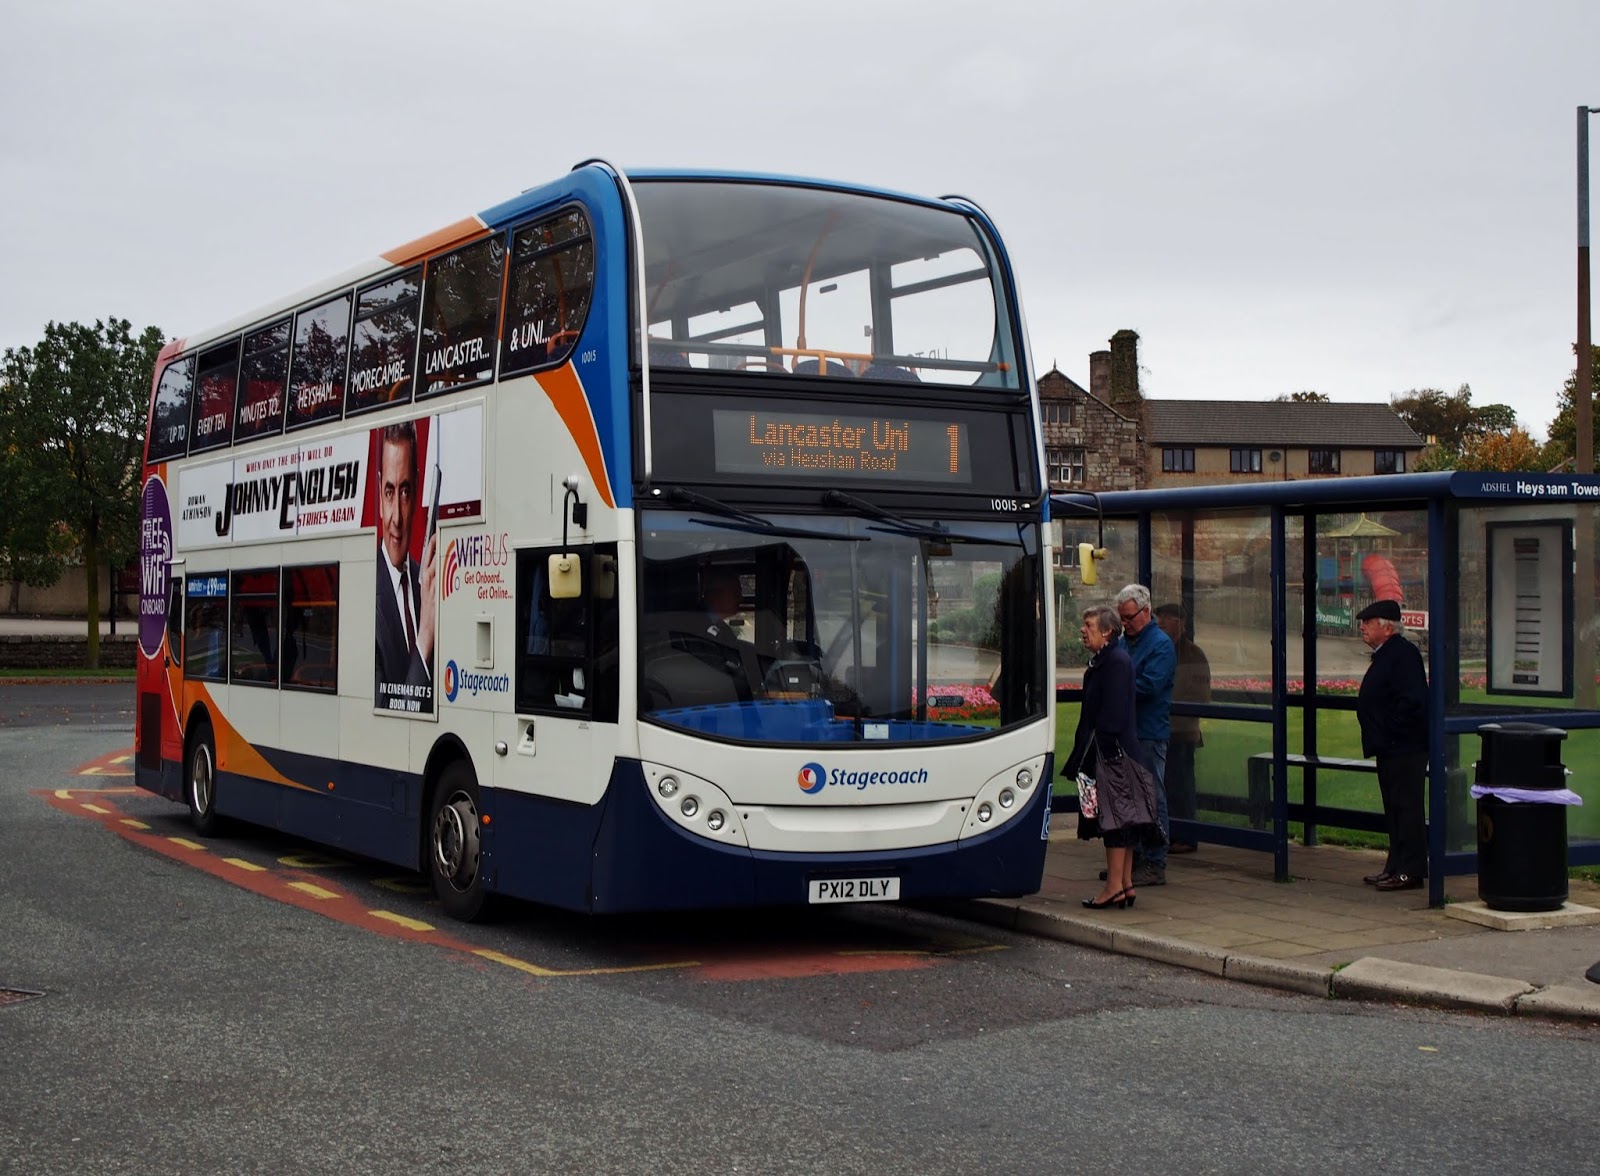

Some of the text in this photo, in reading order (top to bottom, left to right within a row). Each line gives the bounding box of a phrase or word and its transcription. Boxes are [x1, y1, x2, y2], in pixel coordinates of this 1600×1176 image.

[510, 328, 519, 352] &
[425, 337, 490, 374] LANCASTER...
[581, 351, 596, 364] 10015
[351, 359, 411, 393] MORECAMBE...
[239, 400, 267, 425] MINUTES
[169, 424, 186, 443] UP TO
[197, 412, 227, 436] EVERY TEN
[750, 414, 909, 451] Lancaster Uni
[762, 447, 897, 471] via Heysham Road
[946, 425, 958, 473] 1
[246, 446, 333, 473] WHEN ONLY THE BEST WILL DO
[1480, 482, 1511, 493] ADSHEL
[1571, 482, 1600, 496] Towe
[187, 494, 206, 506] ROWAN
[215, 460, 360, 536] JOHNNY ENGLISH
[991, 498, 1017, 512] 10015
[182, 506, 212, 521] ATKINSON
[296, 506, 356, 527] STRIKES AGAIN
[142, 517, 163, 550] FREE
[465, 571, 474, 584] Get
[478, 586, 488, 599] Get
[141, 598, 165, 615] ONBOARD
[1400, 614, 1423, 625] orts
[380, 682, 432, 698] IN CINEMAS OCT 5
[459, 668, 509, 696] Stagecoach
[389, 698, 421, 712] BOOK NOW
[829, 767, 928, 790] Stagecoach
[818, 880, 890, 899] PX12 DLY
